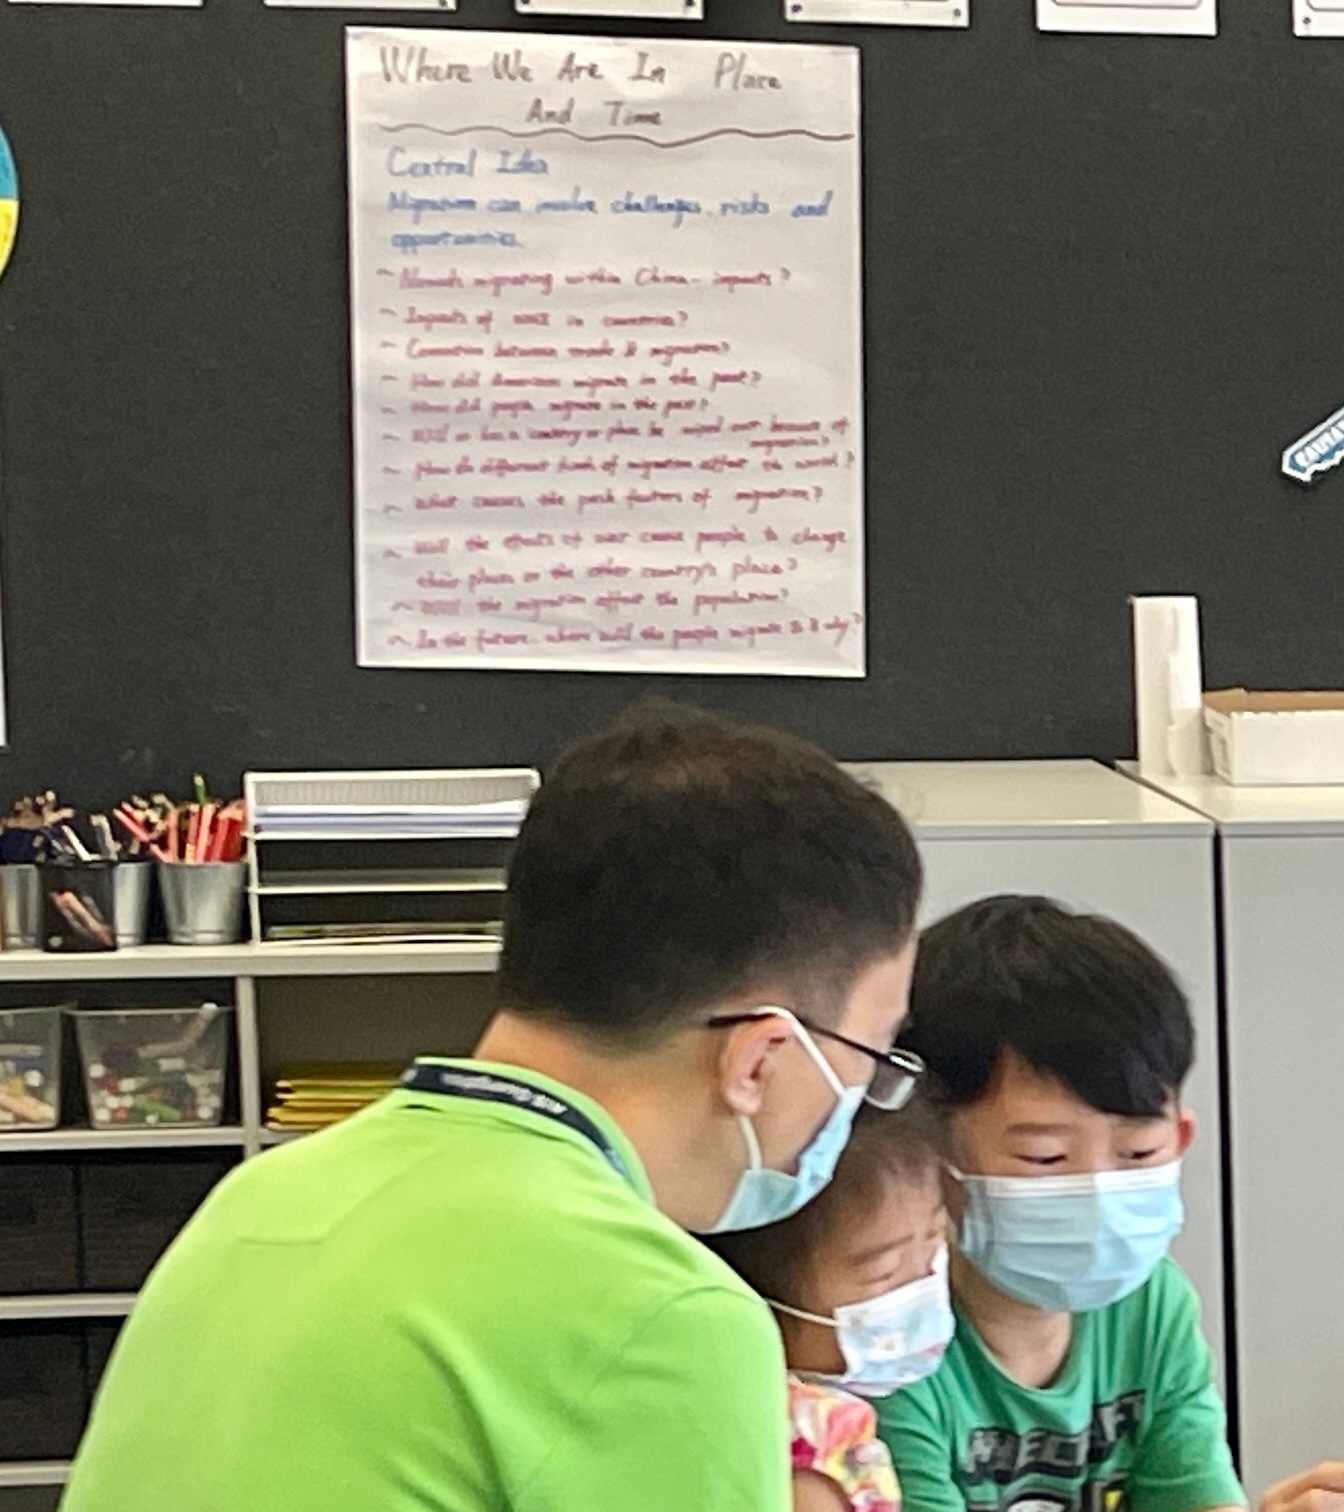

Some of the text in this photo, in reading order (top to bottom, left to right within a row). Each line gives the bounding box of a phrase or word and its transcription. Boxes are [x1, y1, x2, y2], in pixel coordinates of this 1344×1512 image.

[381, 46, 782, 90] Where We Are In Place
[526, 100, 662, 126] And Time
[387, 147, 477, 177] Central
[791, 190, 834, 217] and
